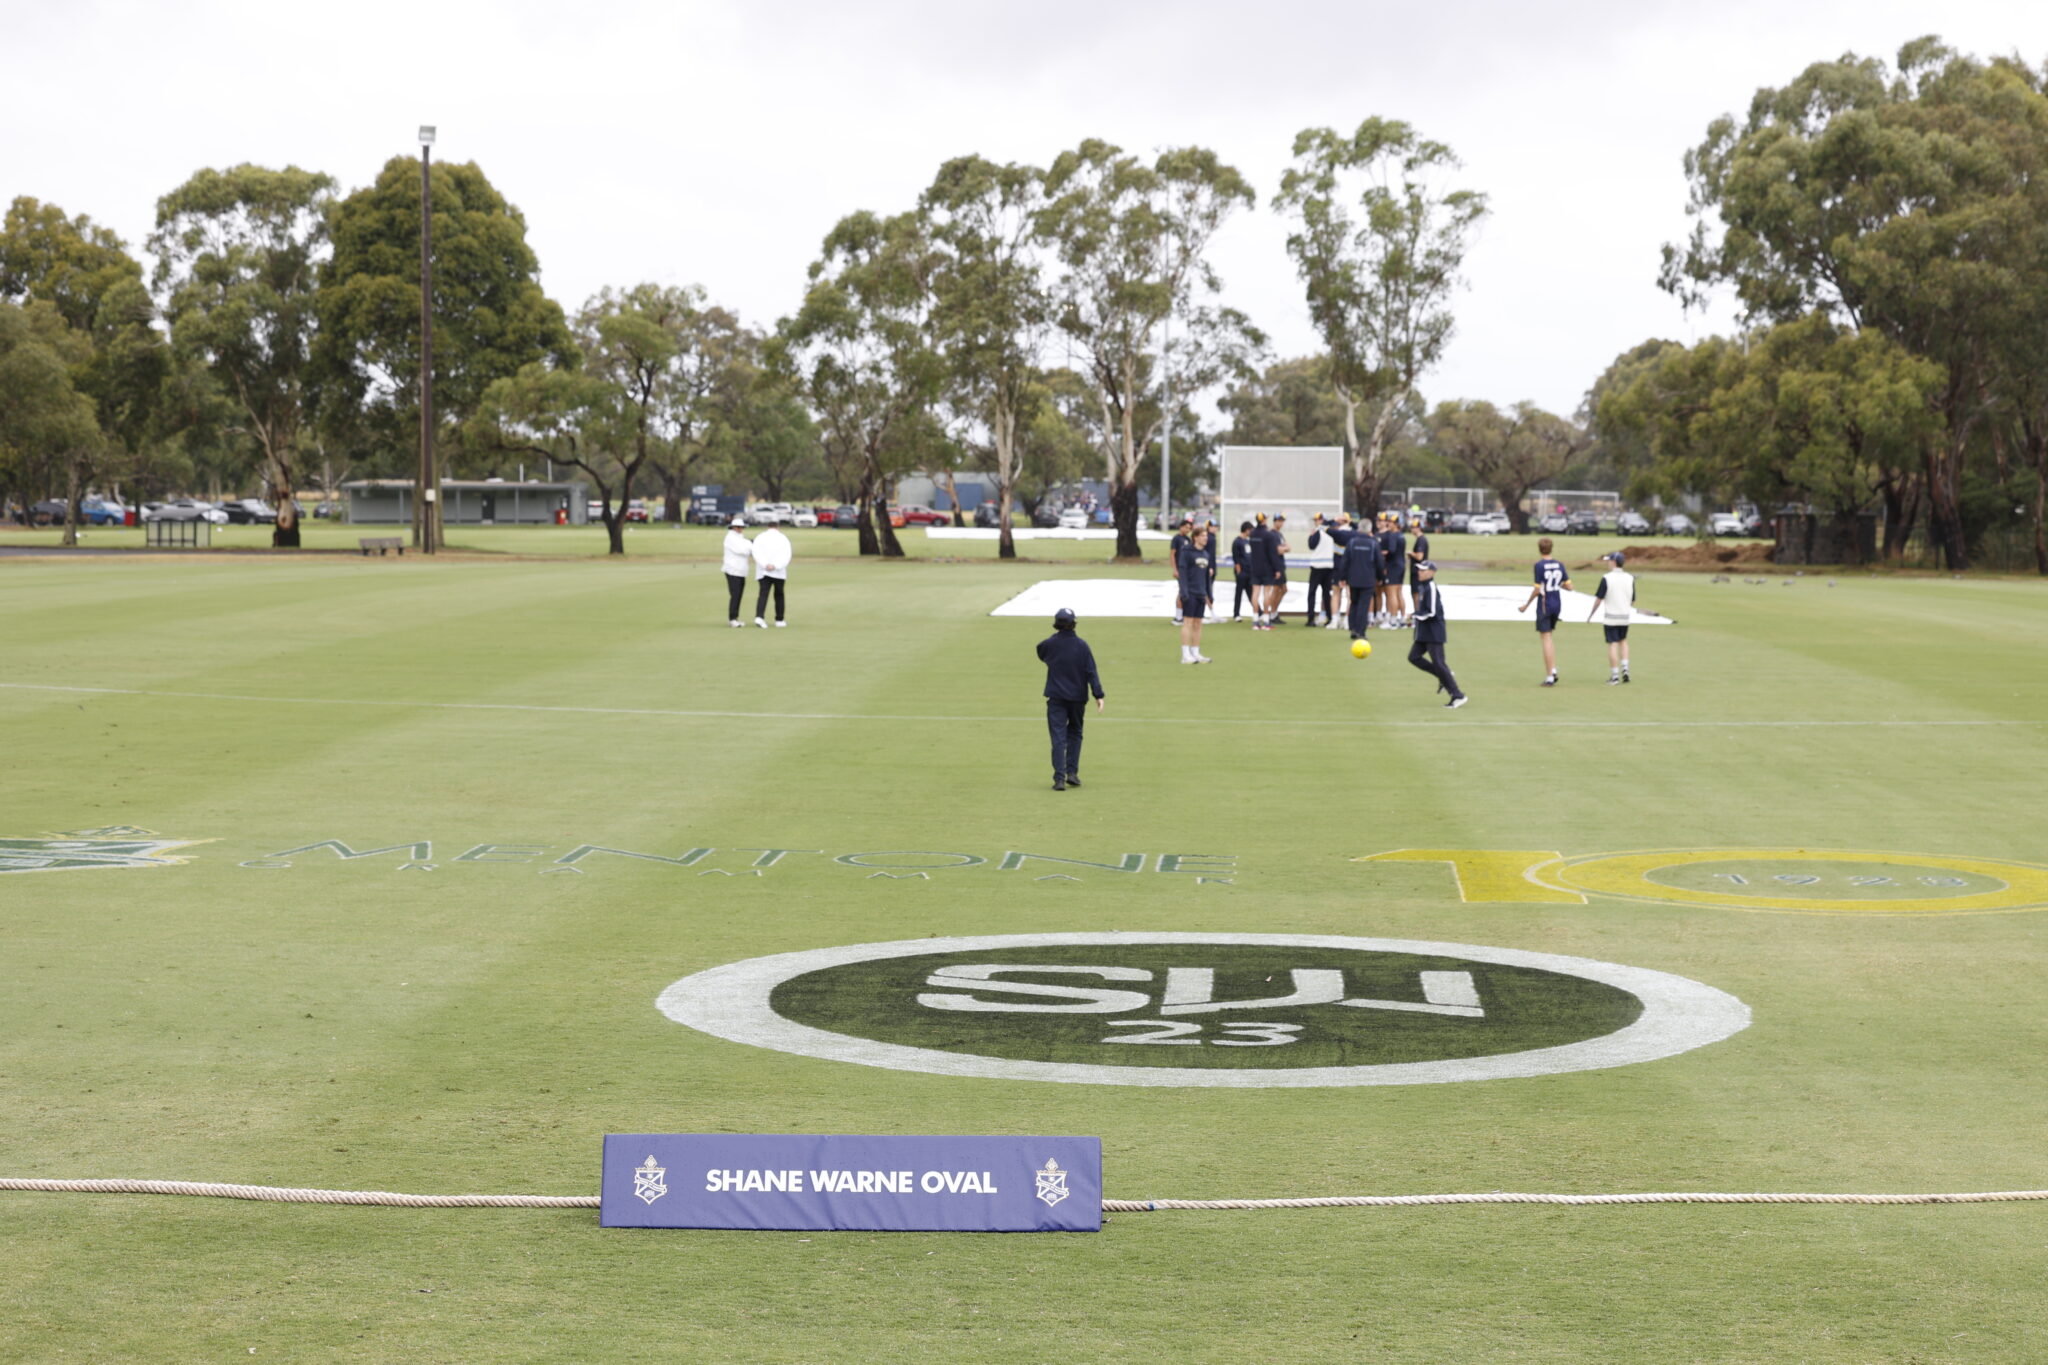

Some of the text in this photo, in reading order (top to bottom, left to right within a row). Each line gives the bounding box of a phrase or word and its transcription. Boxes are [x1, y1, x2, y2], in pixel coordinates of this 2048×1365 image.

[1545, 570, 1563, 592] 22
[264, 838, 1239, 875] MENTONE
[1713, 873, 1969, 888] 1923
[1101, 1020, 1304, 1046] 23
[706, 1169, 998, 1194] SHANE WARNE OVAL
